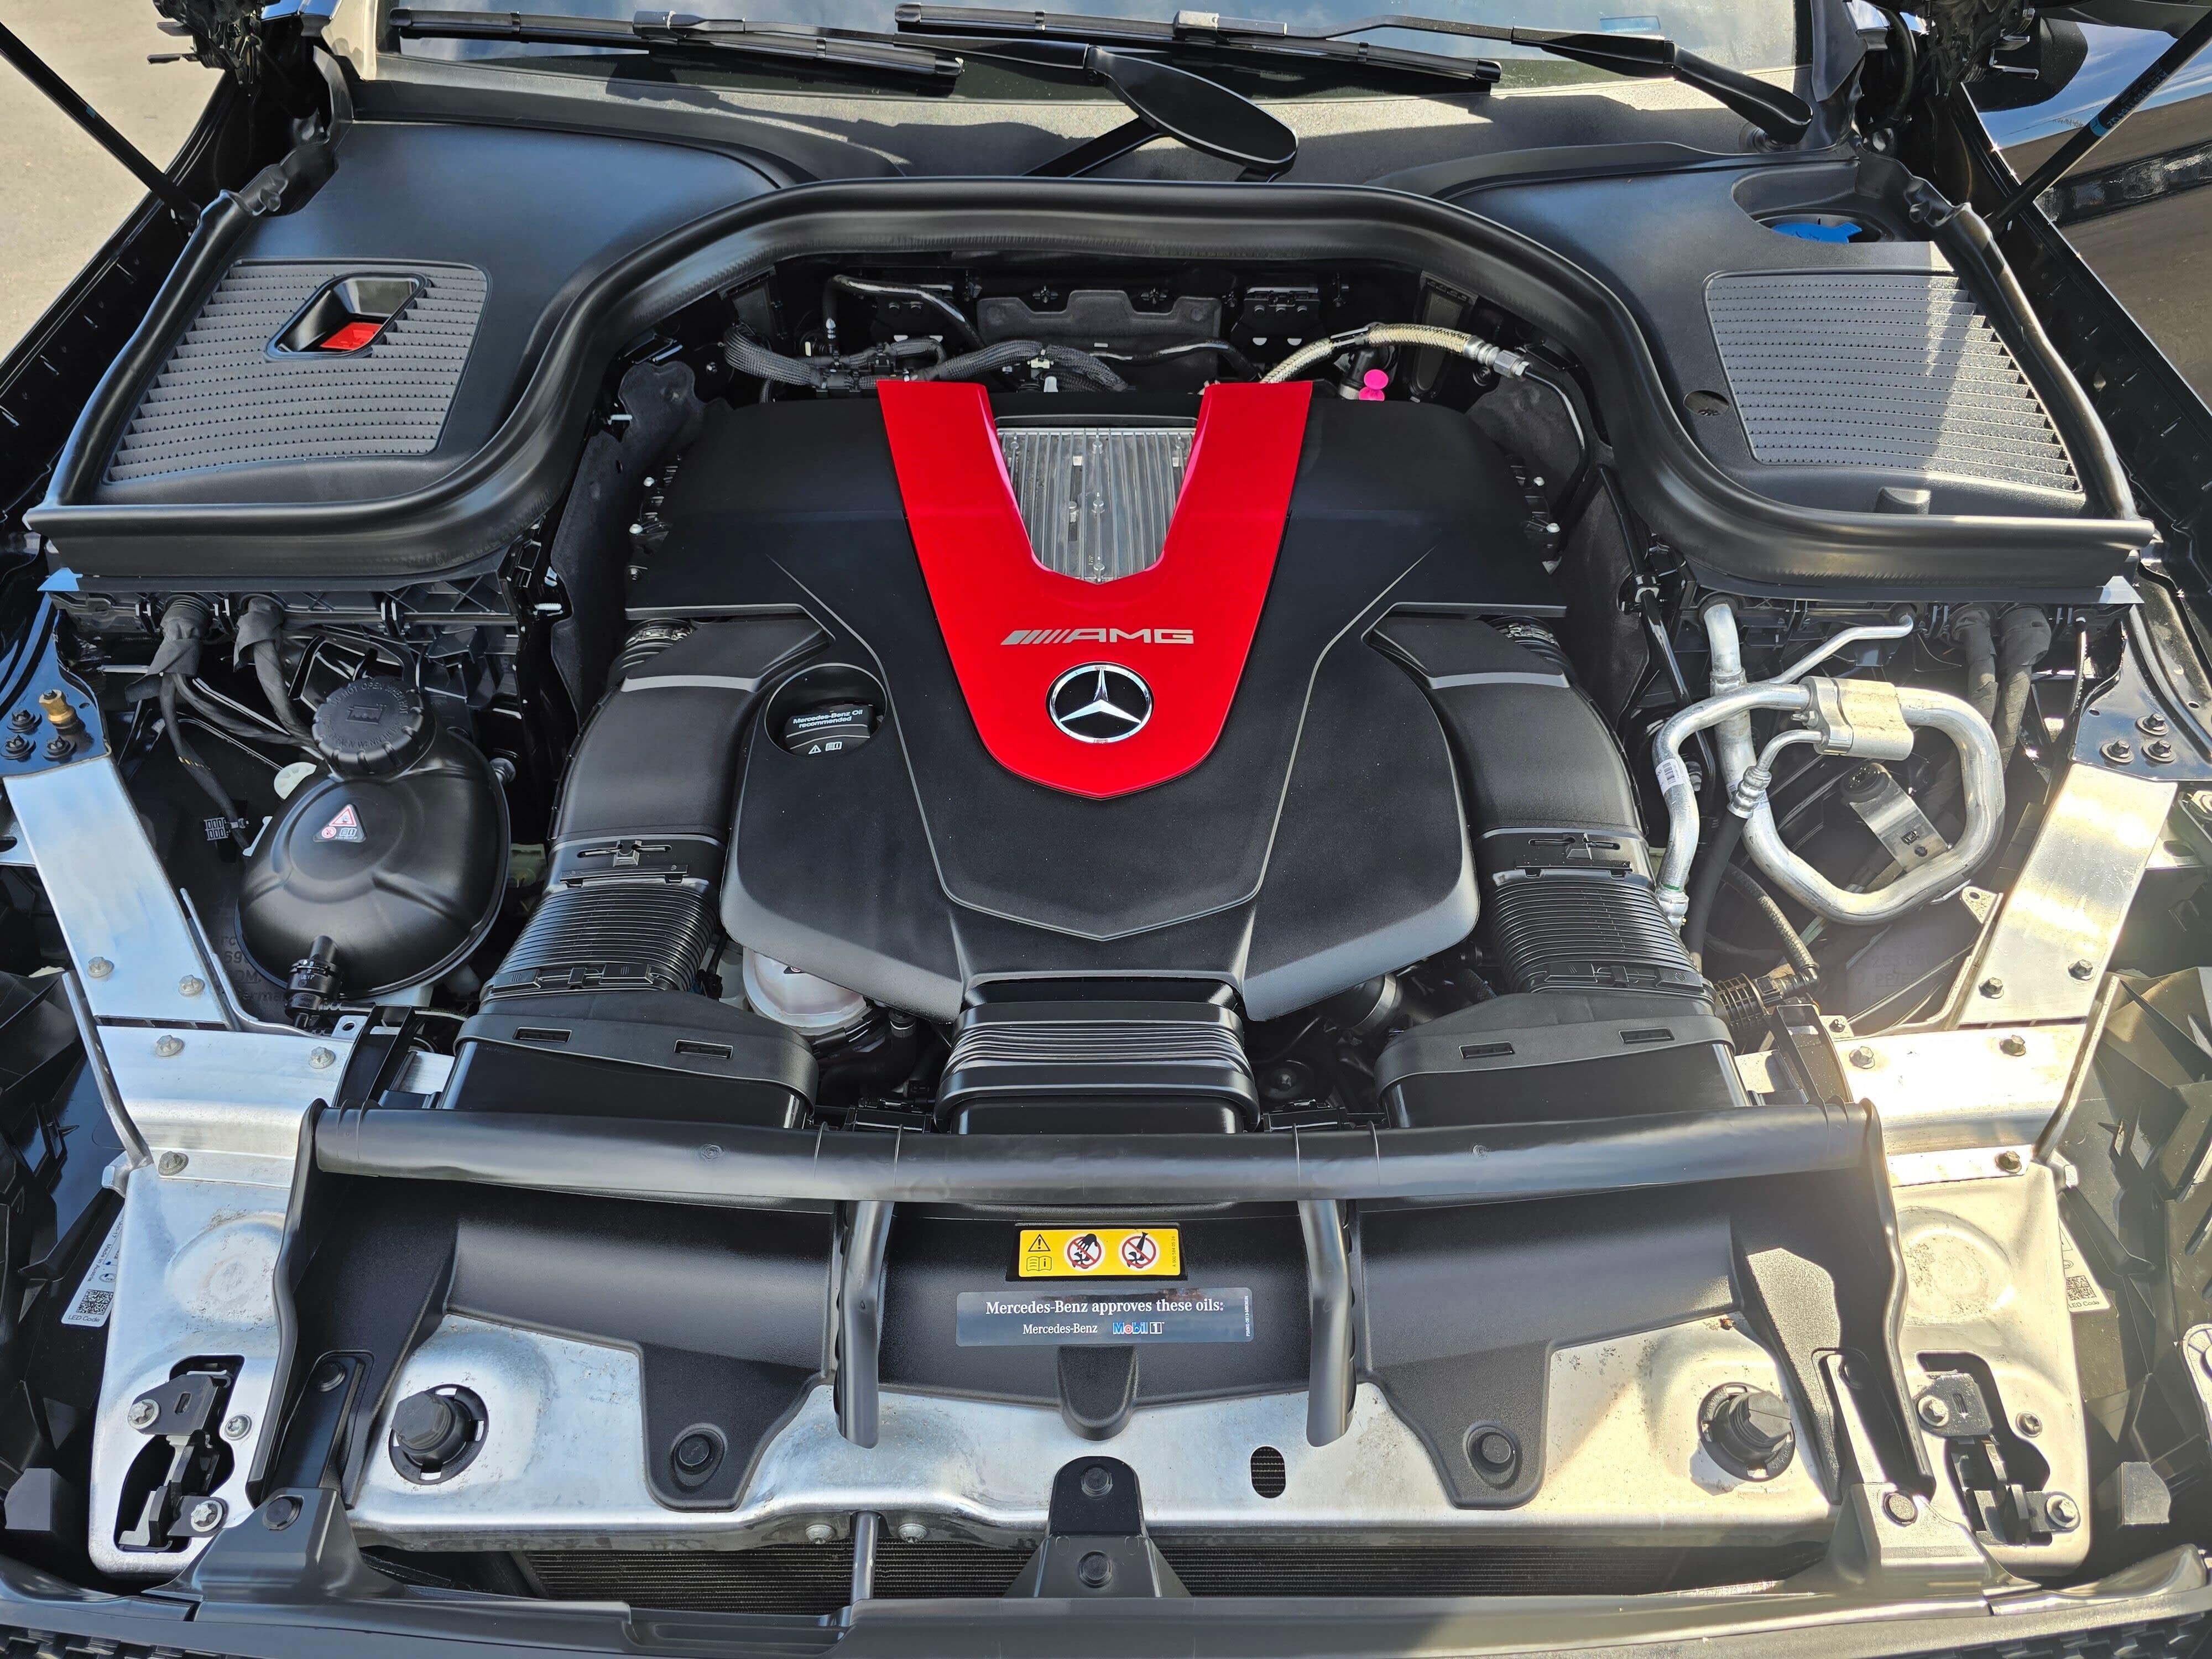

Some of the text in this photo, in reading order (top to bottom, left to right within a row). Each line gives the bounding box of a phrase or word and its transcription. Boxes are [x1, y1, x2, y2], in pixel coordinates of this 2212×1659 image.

[1062, 628, 1194, 645] AMG
[361, 682, 383, 690] OPEN
[793, 711, 851, 724] Mercedes-Benz
[799, 716, 852, 728] recommended
[986, 1299, 1224, 1316] Mercedes-Benz approves these oils:
[1022, 1323, 1098, 1334] Mercedes-Benz
[1113, 1322, 1148, 1334] Mobil
